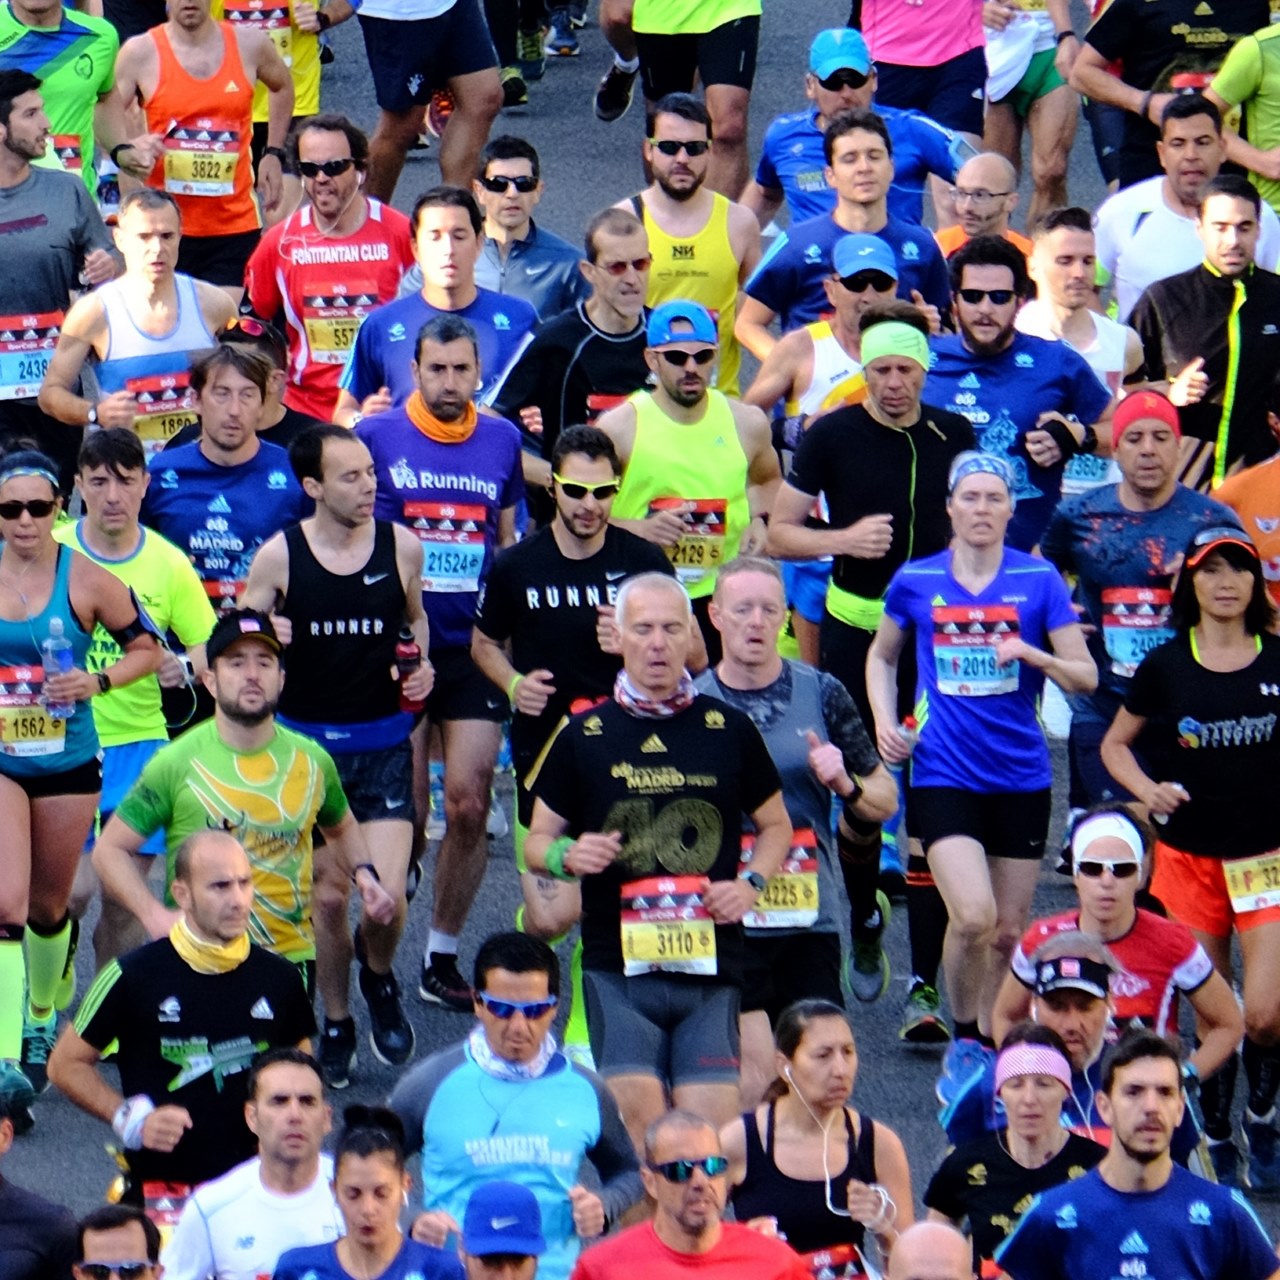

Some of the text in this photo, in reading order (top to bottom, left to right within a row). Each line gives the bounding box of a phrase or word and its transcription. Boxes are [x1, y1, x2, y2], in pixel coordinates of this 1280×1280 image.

[190, 159, 222, 180] 3822
[361, 243, 390, 262] CLUB
[421, 470, 497, 496] Running
[189, 534, 244, 551] MADRID
[427, 550, 468, 574] 21524
[310, 620, 384, 637] RUNNER
[13, 716, 47, 738] 1562
[627, 773, 687, 789] MADRID
[656, 931, 694, 956] 3110
